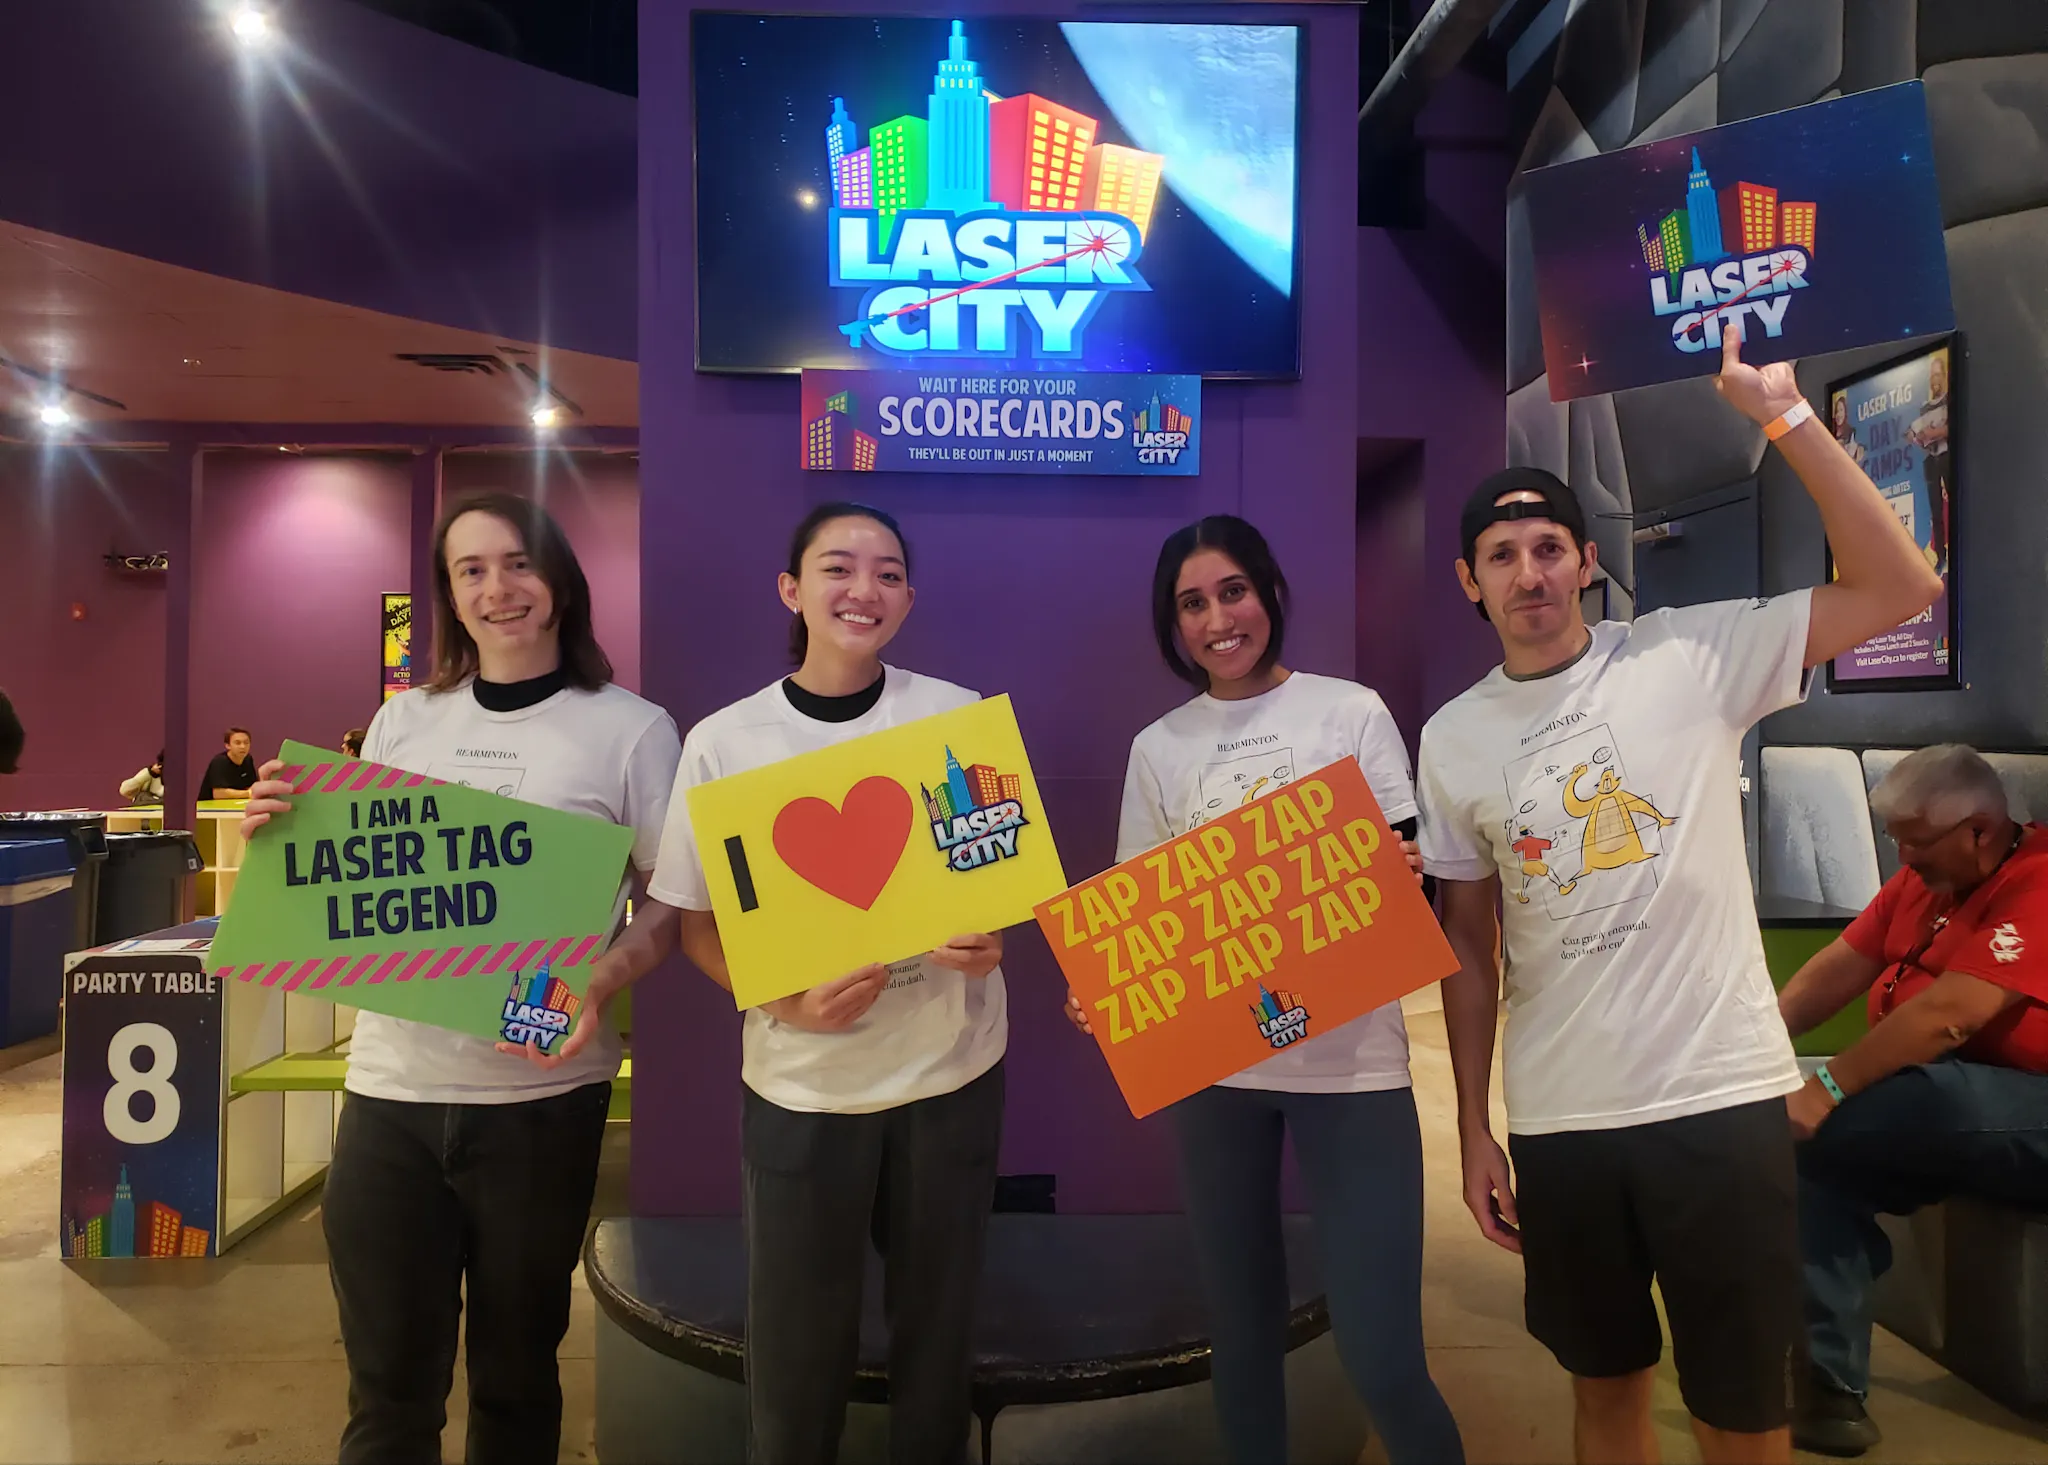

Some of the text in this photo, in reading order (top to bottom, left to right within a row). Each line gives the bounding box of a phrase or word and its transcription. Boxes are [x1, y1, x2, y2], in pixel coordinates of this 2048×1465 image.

[839, 217, 1135, 284] LASER
[1650, 249, 1810, 316] LASER
[869, 286, 1098, 352] CITY
[1672, 294, 1791, 354] CITY
[918, 377, 1077, 396] WAIT HERE FOR YOUR
[1857, 383, 1912, 422] LASER TAG
[878, 396, 1125, 440] SCORECARDS
[1869, 415, 1902, 452] DAY
[908, 446, 1093, 463] THEY'LL BE OUT IN JUST A MOMENT
[1133, 432, 1187, 448] LASER
[1138, 448, 1180, 464] CITY
[1855, 651, 1928, 667] Visit LaserCity.ca to register
[1217, 733, 1279, 752] BEARMINTON
[1520, 711, 1588, 746] BRMINTON
[455, 748, 519, 760] BEARMINTON
[350, 795, 440, 830] I AM A
[933, 801, 1027, 849] LASER
[284, 821, 533, 887] LASER TAG
[951, 829, 1018, 870] CITY
[1049, 779, 1334, 948] ZAP ZAP ZAP
[724, 835, 759, 913] I
[327, 880, 498, 941] LEGEND
[1093, 818, 1380, 987] ZAP ZAP ZAP
[1095, 876, 1382, 1045] ZAP ZAP ZAP
[1597, 944, 1607, 953] to
[73, 972, 216, 994] PARTY TABLE
[898, 978, 906, 988] in
[906, 972, 927, 985] death.
[503, 1001, 569, 1033] LASER
[505, 1020, 558, 1048] CITY
[1259, 1006, 1308, 1038] LASER
[1271, 1020, 1306, 1047] CITY
[103, 1022, 181, 1145] 8
